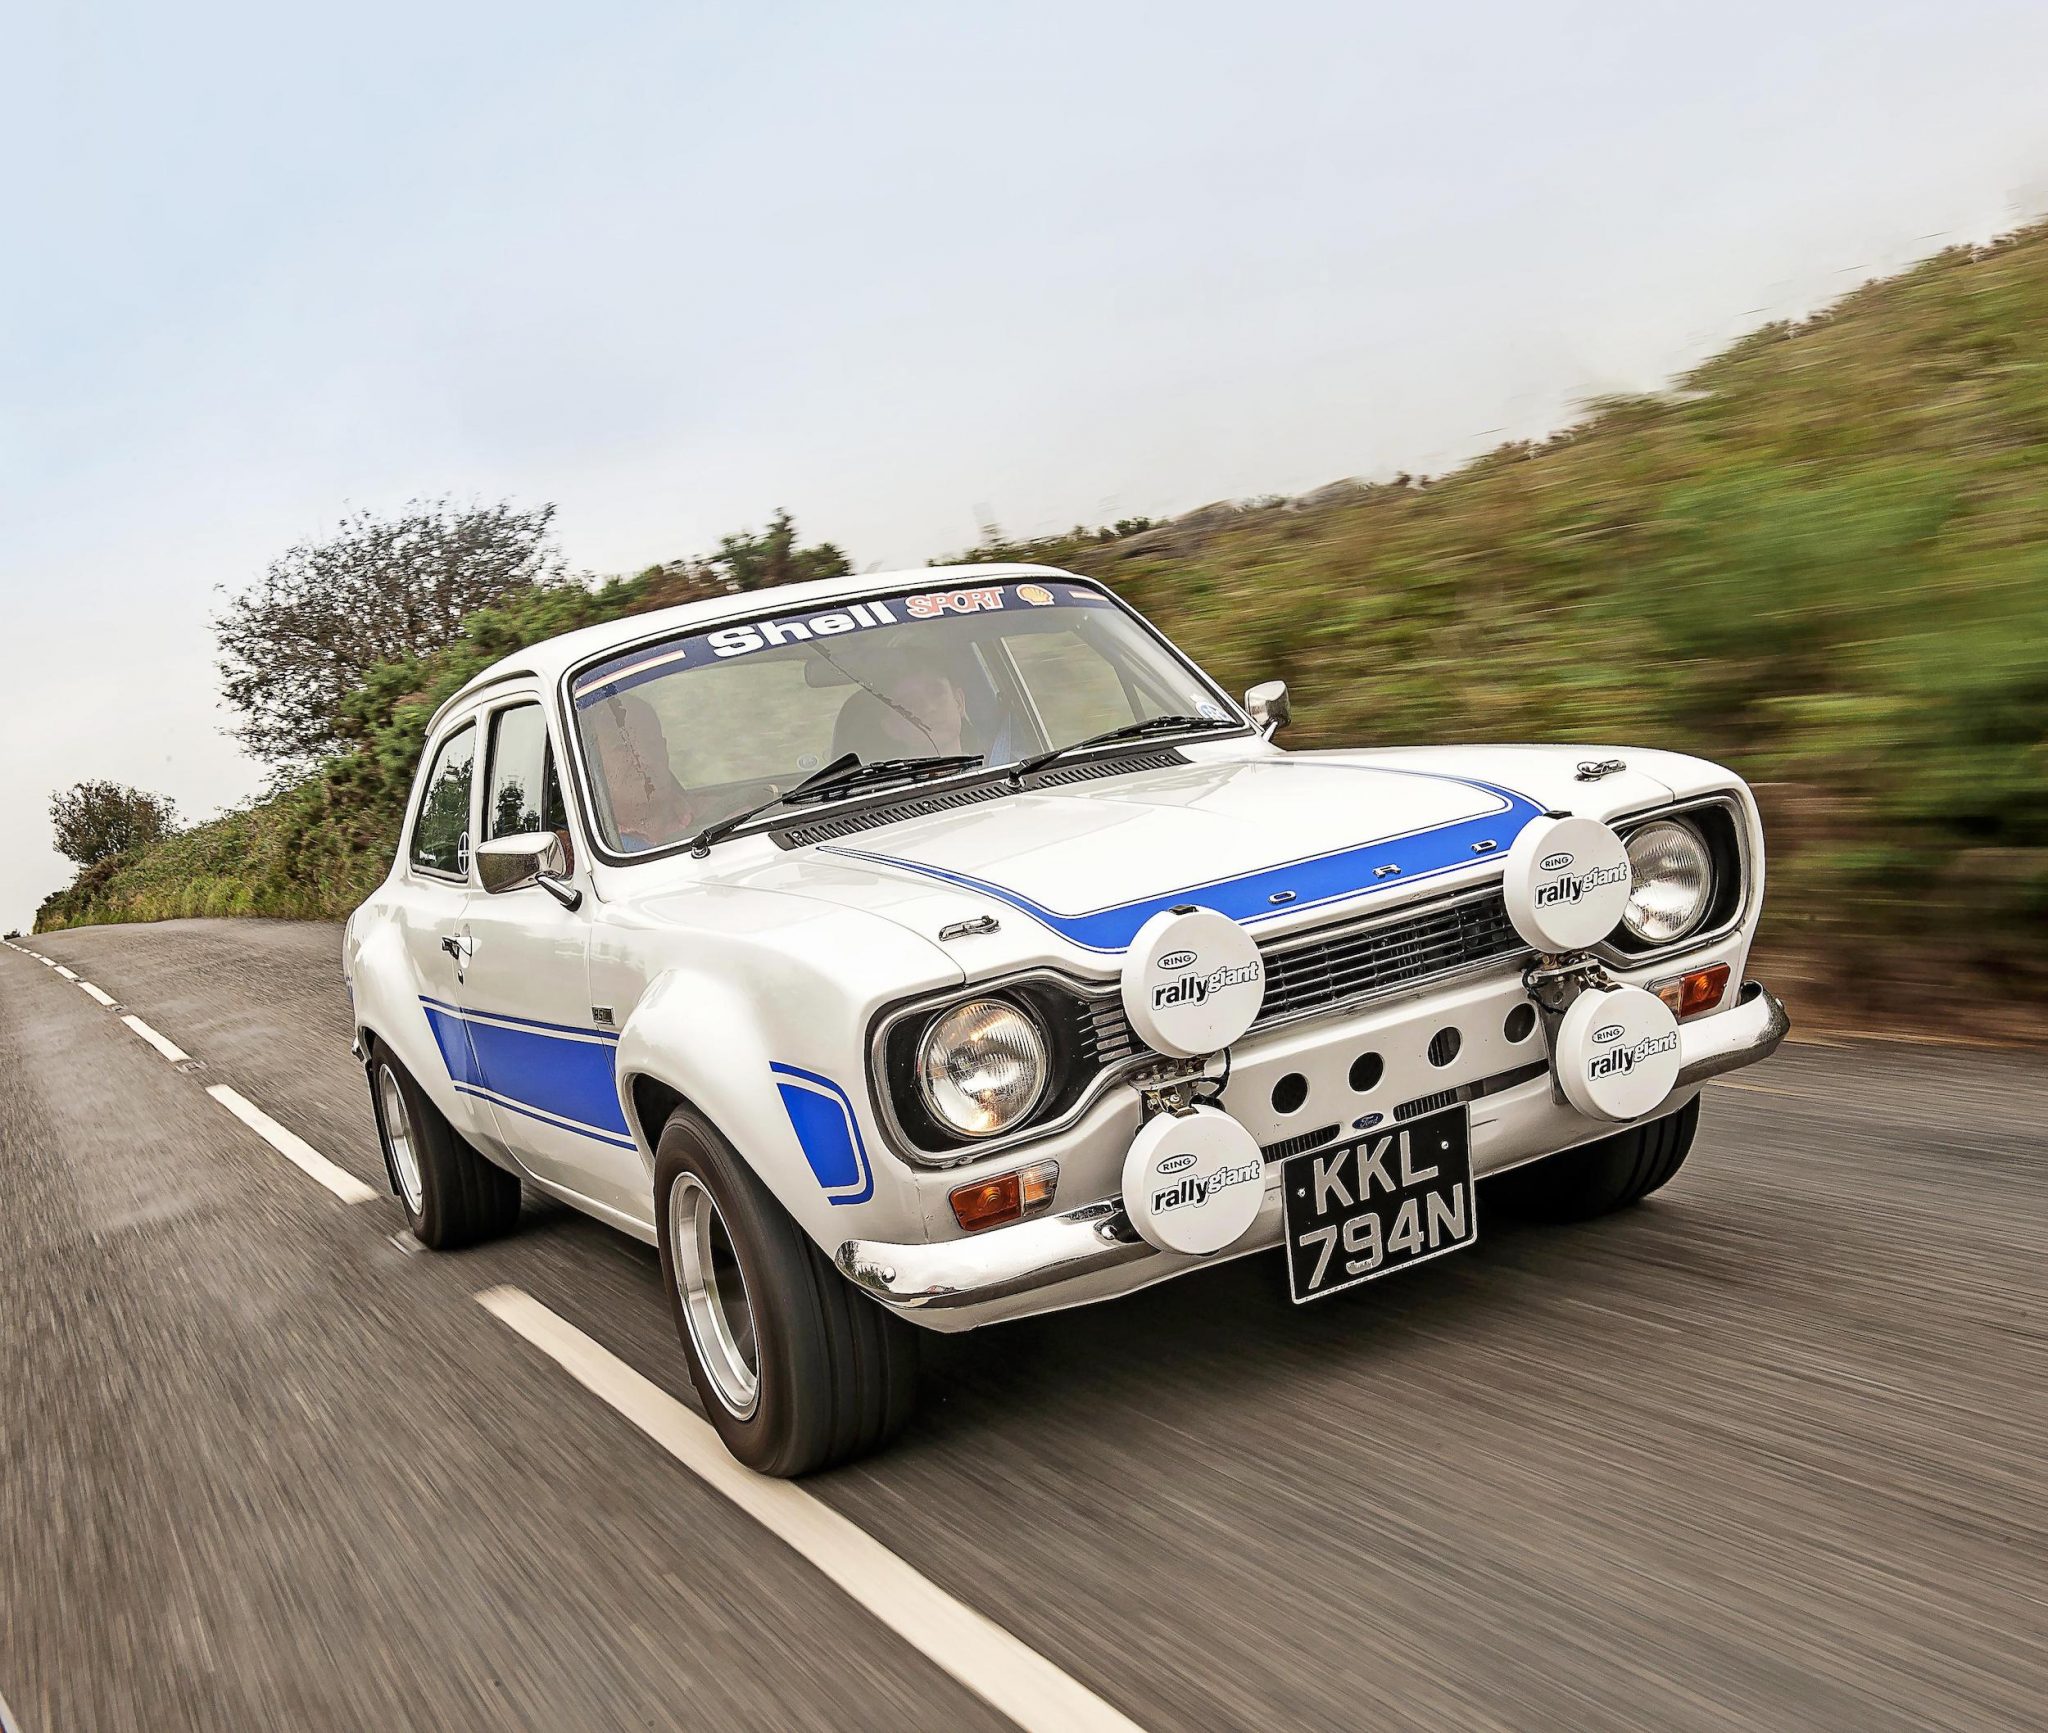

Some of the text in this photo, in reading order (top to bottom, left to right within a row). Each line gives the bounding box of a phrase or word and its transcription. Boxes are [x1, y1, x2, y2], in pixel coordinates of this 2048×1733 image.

[706, 586, 1005, 658] Shell SPORT
[1268, 839, 1497, 905] ORD
[1535, 862, 1627, 909] rallygiant
[1545, 857, 1569, 868] RING
[1163, 954, 1192, 967] RING
[1152, 961, 1259, 1011] rallygiant
[1588, 1031, 1677, 1081] rallygiant
[1597, 1028, 1620, 1041] RING
[1151, 1160, 1260, 1215] rallygiant
[1163, 1157, 1191, 1171] RING
[1313, 1130, 1439, 1216] KKL
[1299, 1183, 1466, 1290] 794N
